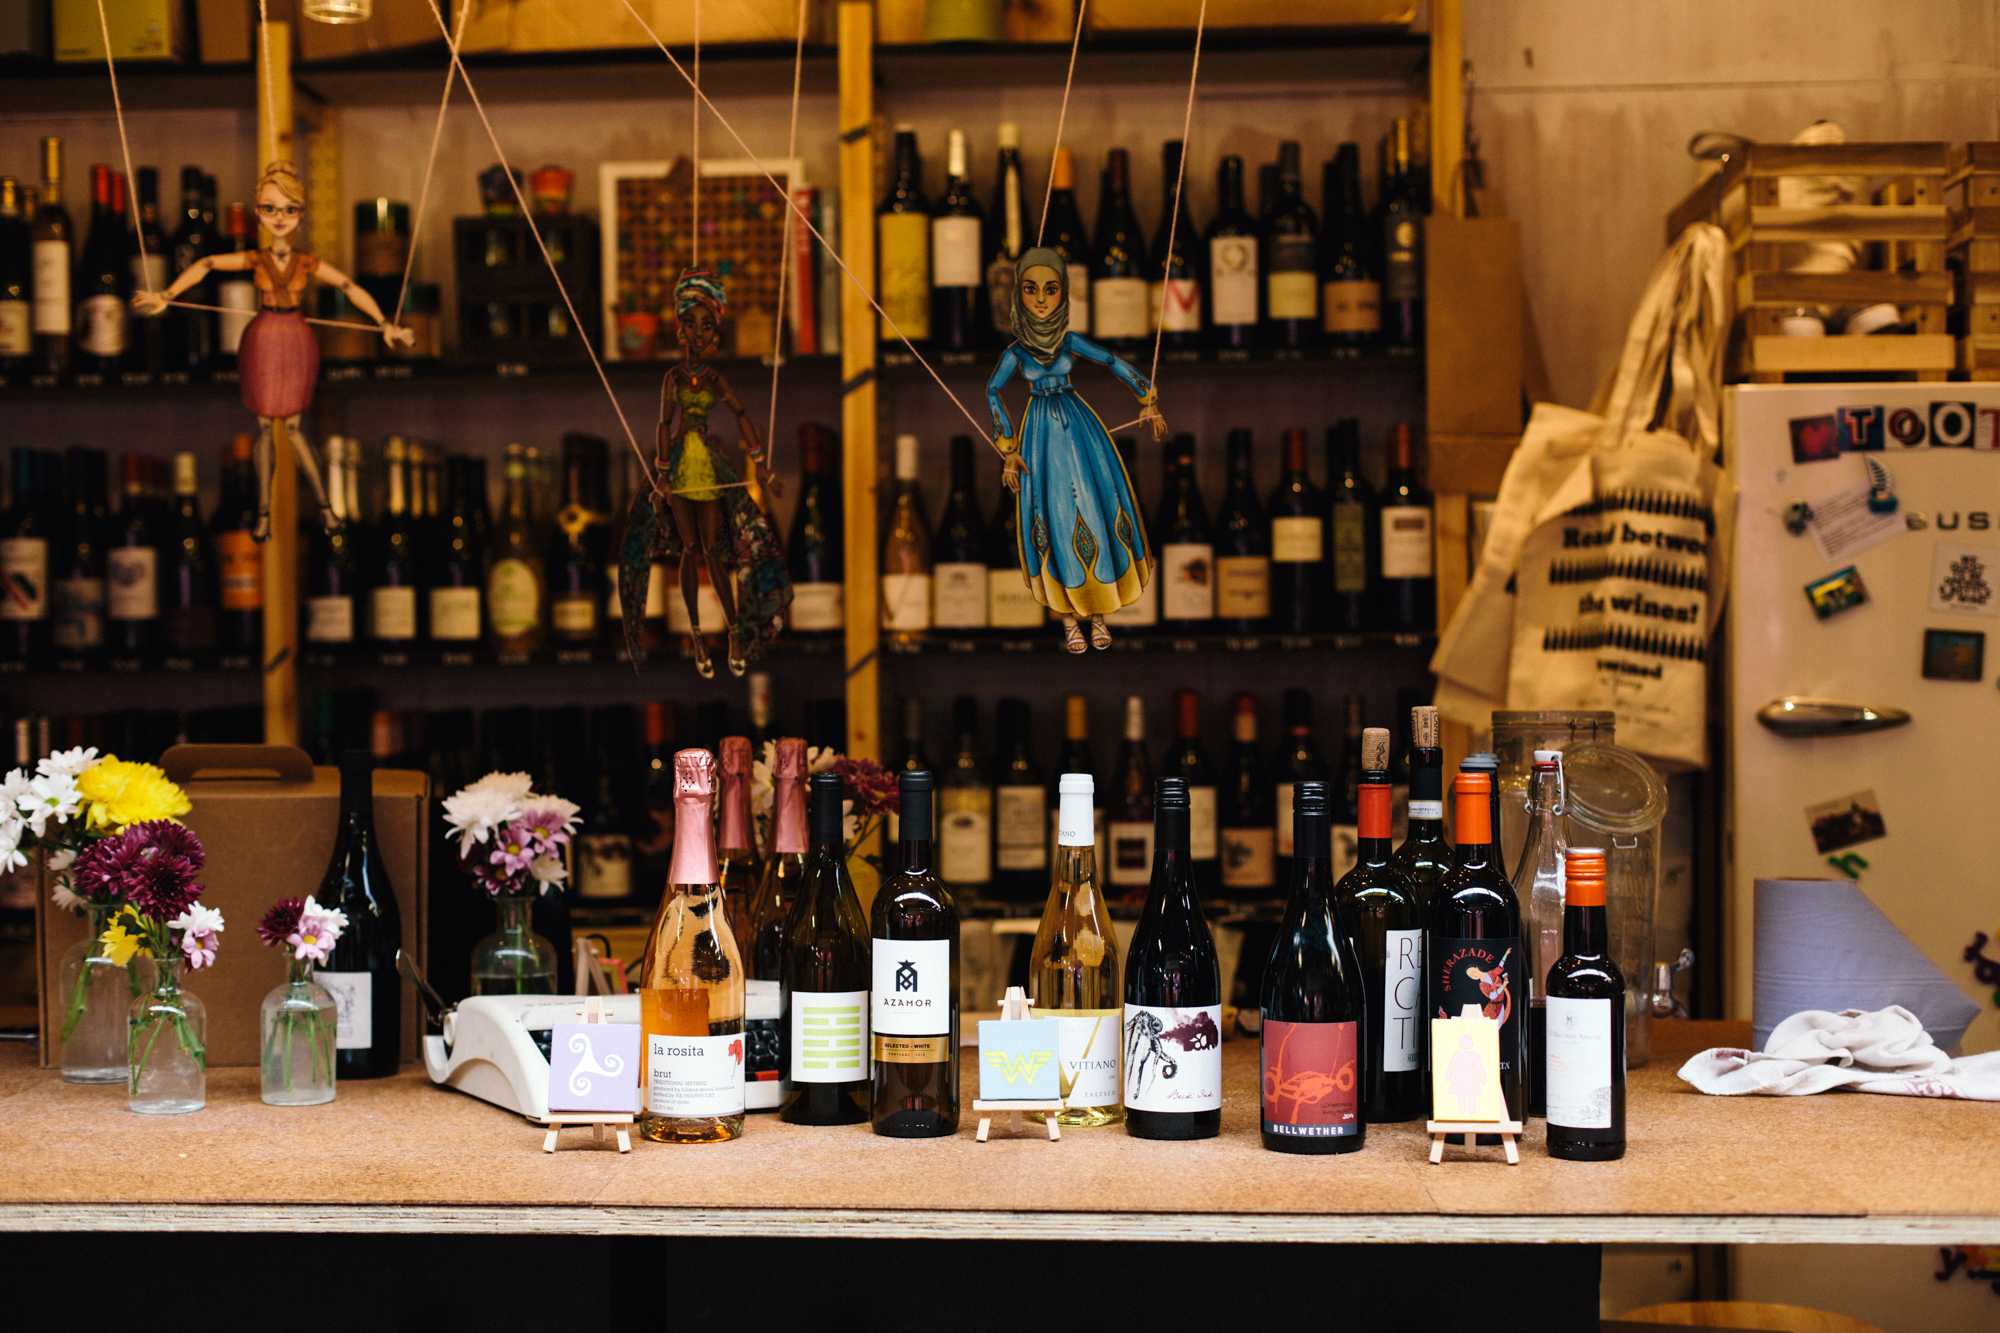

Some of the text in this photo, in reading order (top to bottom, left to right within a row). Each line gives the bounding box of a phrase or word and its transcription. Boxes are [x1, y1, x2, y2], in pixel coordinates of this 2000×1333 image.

[1622, 522, 1706, 554] betwe
[1443, 948, 1495, 992] SHERAZADE
[884, 998, 932, 1007] AZAMOR
[654, 1043, 704, 1056] la rosita
[1070, 1060, 1116, 1070] VITIANO
[653, 1069, 671, 1078] brut
[1273, 1124, 1344, 1136] BELLWETHER
